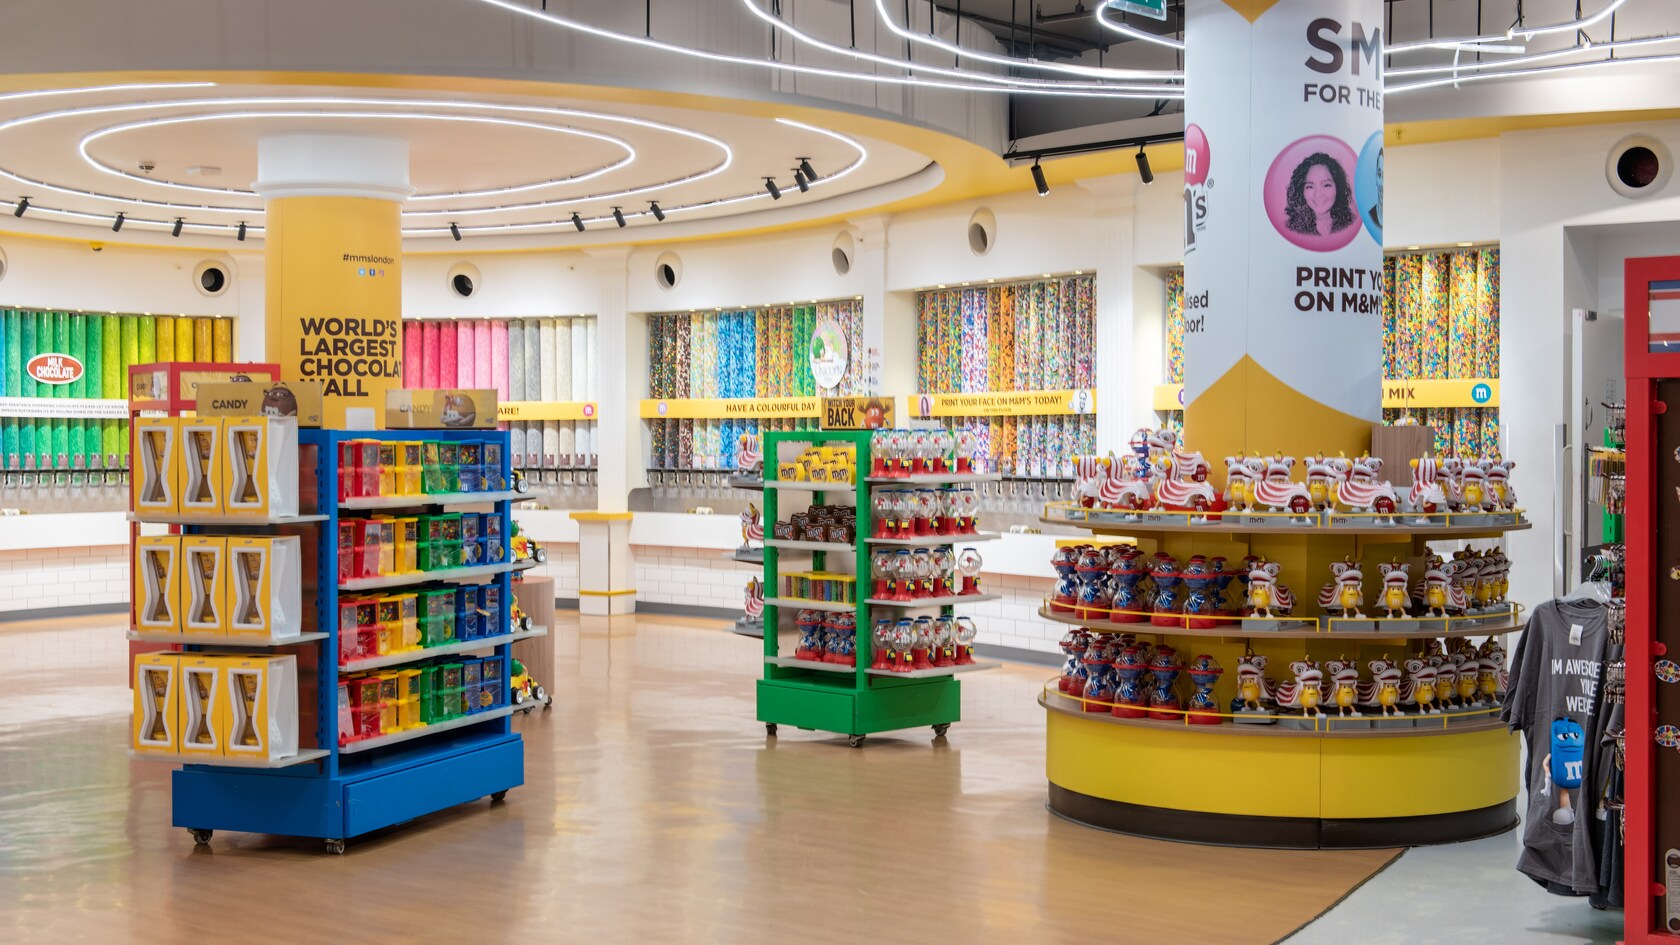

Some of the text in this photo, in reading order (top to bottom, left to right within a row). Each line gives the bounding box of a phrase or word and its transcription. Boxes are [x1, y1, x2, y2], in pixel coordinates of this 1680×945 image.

[1303, 83, 1381, 110] FOR THE
[343, 253, 394, 264] #mmslondon
[1296, 266, 1366, 289] PRINT
[1294, 290, 1334, 312] ON
[300, 317, 398, 338] WORLD'S
[300, 338, 397, 358] LARGEST
[47, 356, 63, 367] MILK
[300, 357, 401, 378] CHOCOLA
[36, 365, 74, 379] CHOCOLATE
[1388, 387, 1416, 399] MIX
[1475, 387, 1487, 399] m
[212, 399, 249, 409] CANDY
[726, 402, 816, 413] HAVE A COLOURFUL DAY
[941, 396, 1063, 407] PRINT YOUR FACE ON M&M'S TODAY!
[399, 404, 432, 413] CANDY
[827, 408, 856, 427] BACK
